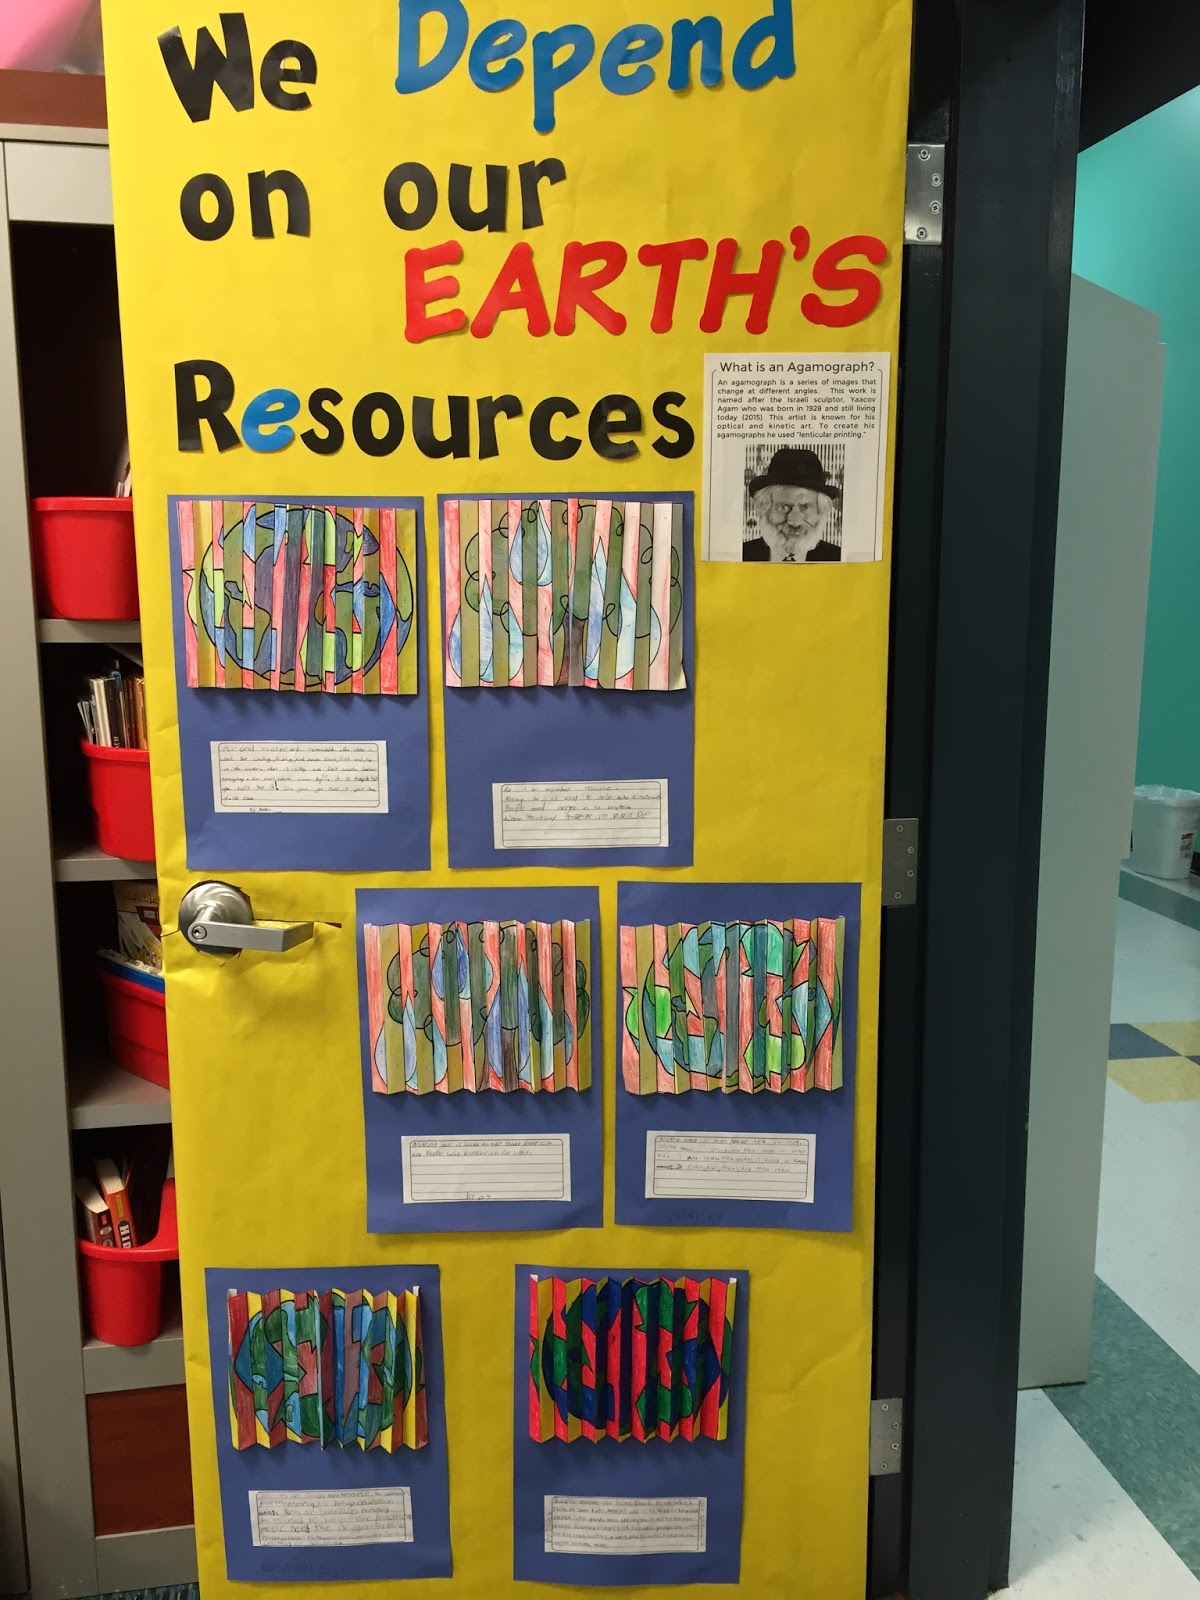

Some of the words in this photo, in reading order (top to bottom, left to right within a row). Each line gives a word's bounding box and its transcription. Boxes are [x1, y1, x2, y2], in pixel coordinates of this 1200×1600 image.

[158, 12, 318, 123] We
[396, 0, 795, 134] Depend
[180, 170, 311, 241] on
[384, 158, 567, 233] our
[405, 227, 887, 342] EARTH'S
[719, 361, 752, 372] What
[756, 361, 766, 372] is
[769, 364, 784, 372] an
[787, 361, 875, 375] Agamograph?
[717, 378, 728, 386] An
[731, 378, 777, 388] agamograph
[779, 378, 786, 386] is
[797, 378, 818, 386] series
[821, 378, 830, 386] of
[832, 378, 859, 388] images
[861, 378, 877, 386] that
[717, 387, 744, 396] change
[747, 387, 755, 395] at
[759, 387, 790, 395] different
[829, 387, 845, 395] This
[848, 387, 867, 395] work
[870, 387, 877, 395] is
[717, 396, 743, 404] named
[747, 396, 765, 404] after
[770, 396, 782, 404] the
[787, 396, 809, 404] Israeli
[850, 396, 876, 404] Yaacov
[175, 359, 695, 461] Resources
[717, 405, 739, 414] Agam
[856, 405, 876, 414] living
[717, 414, 737, 423] today
[769, 414, 784, 422] This
[788, 414, 807, 422] artist
[811, 414, 817, 422] is
[821, 414, 845, 422] known
[850, 414, 860, 422] for
[864, 414, 875, 422] his
[716, 422, 744, 432] optical
[749, 422, 764, 430] and
[768, 422, 795, 430] kinetic
[800, 422, 814, 430] art.
[819, 422, 829, 430] To
[833, 422, 859, 430] create
[863, 422, 875, 430] his
[716, 431, 765, 440] agamographs
[767, 431, 776, 439] he
[777, 431, 795, 439] used
